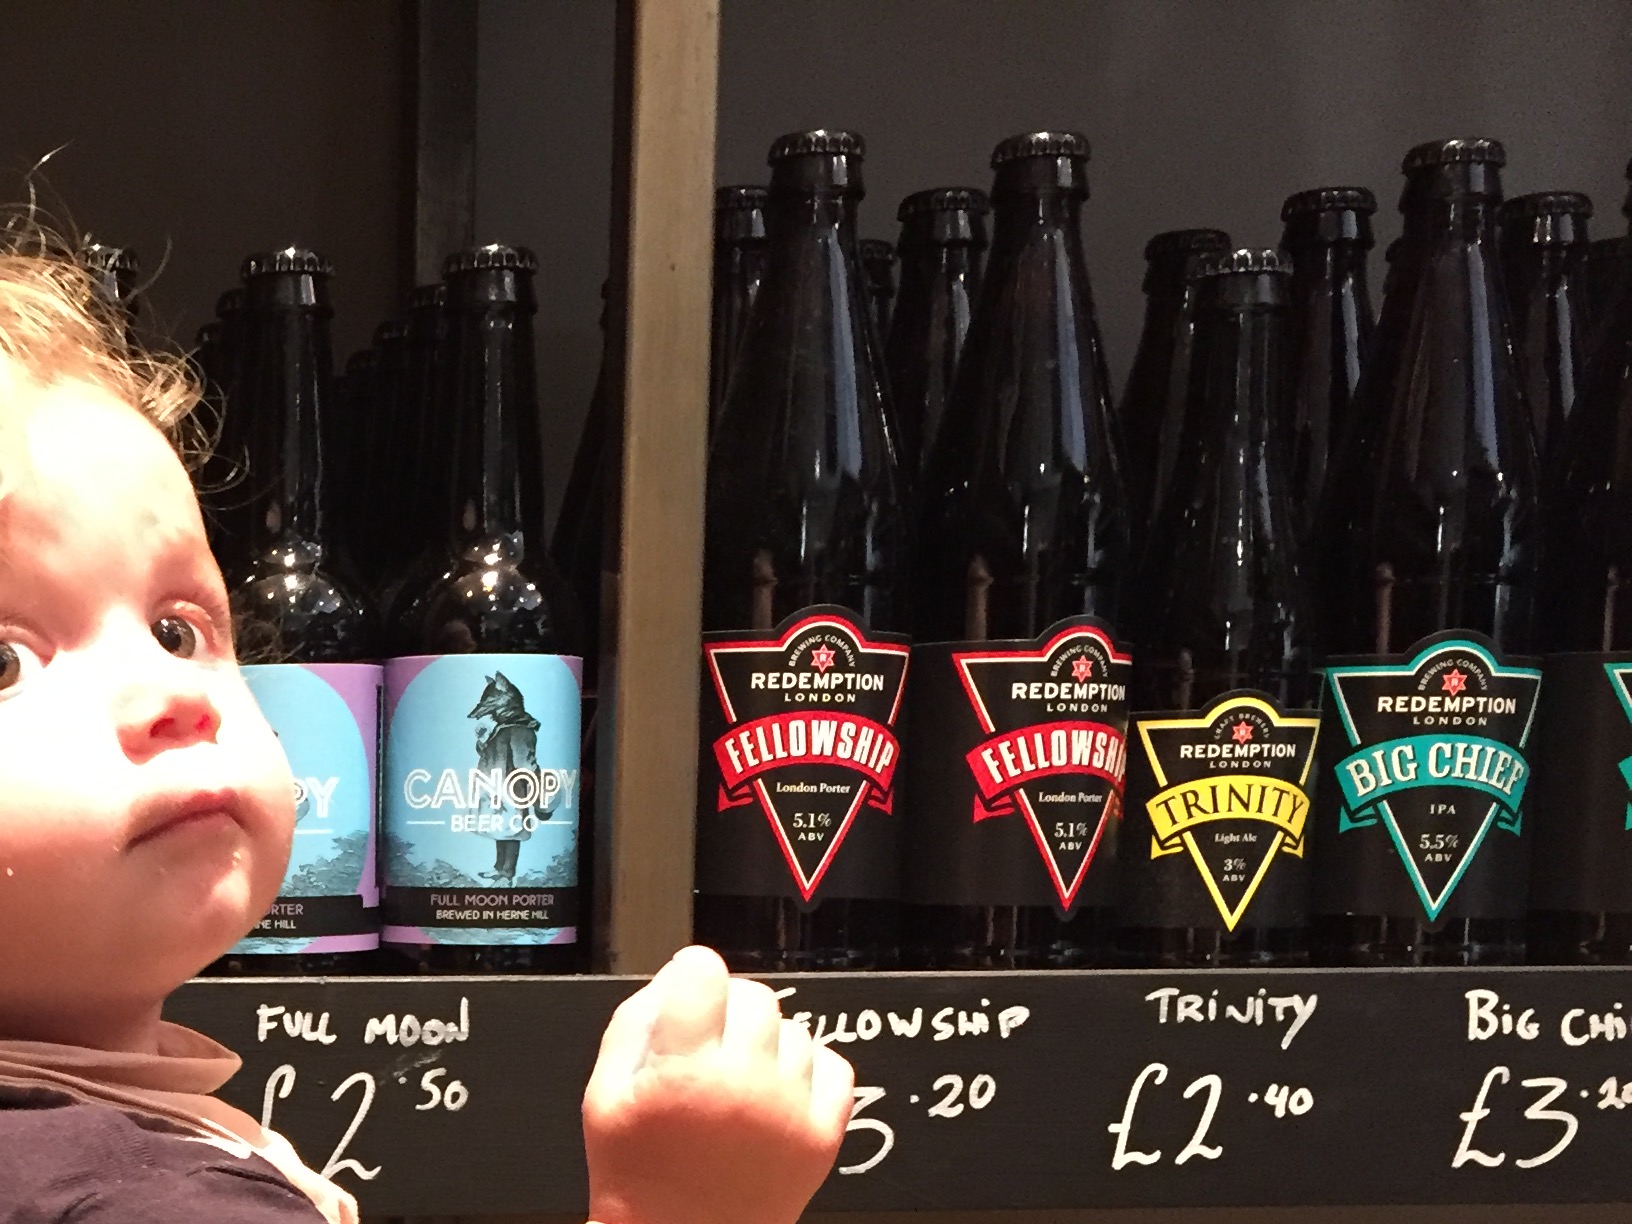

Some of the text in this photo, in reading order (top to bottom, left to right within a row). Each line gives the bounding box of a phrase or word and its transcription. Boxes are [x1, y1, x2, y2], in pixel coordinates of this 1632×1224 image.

[788, 634, 855, 667] BREWING COMPANY
[1050, 645, 1108, 677] BREWING COMPANY
[751, 672, 884, 691] REDEMPTION
[1418, 659, 1488, 691] BREWING COMPANY
[784, 693, 856, 703] LONDON
[1011, 682, 1126, 701] REDEMPTION
[1047, 703, 1108, 712] LONDON
[1377, 696, 1516, 714] REDEMPTION
[1413, 716, 1487, 726] LONDON
[724, 720, 894, 774] FELLOWSHIP
[1180, 744, 1296, 758] REDEMPTION
[1209, 760, 1272, 769] LONDON
[1346, 742, 1525, 797] BIG CHIEF
[404, 768, 577, 809] CANOPY
[776, 782, 850, 794] London Porter
[1039, 792, 1103, 803] London Porter
[1156, 782, 1304, 827] TRINITY
[1430, 804, 1456, 814] IPA
[451, 815, 538, 832] BEER CO
[792, 813, 832, 828] 5.1%
[798, 832, 825, 841] ABV
[1054, 823, 1088, 838] 5.1%
[1214, 833, 1257, 844] Light Ale
[1419, 834, 1459, 850] 5.5%
[1059, 842, 1082, 851] ABV
[1223, 858, 1246, 871] 3%
[1424, 854, 1452, 862] ABV
[1222, 874, 1245, 882] ABV
[430, 894, 554, 906] FULL MOON PORTER
[436, 910, 549, 920] BREWED IN HERNE HILL
[275, 920, 296, 929] HILL
[257, 1004, 337, 1045] FULL
[1560, 1002, 1632, 1046] CHI
